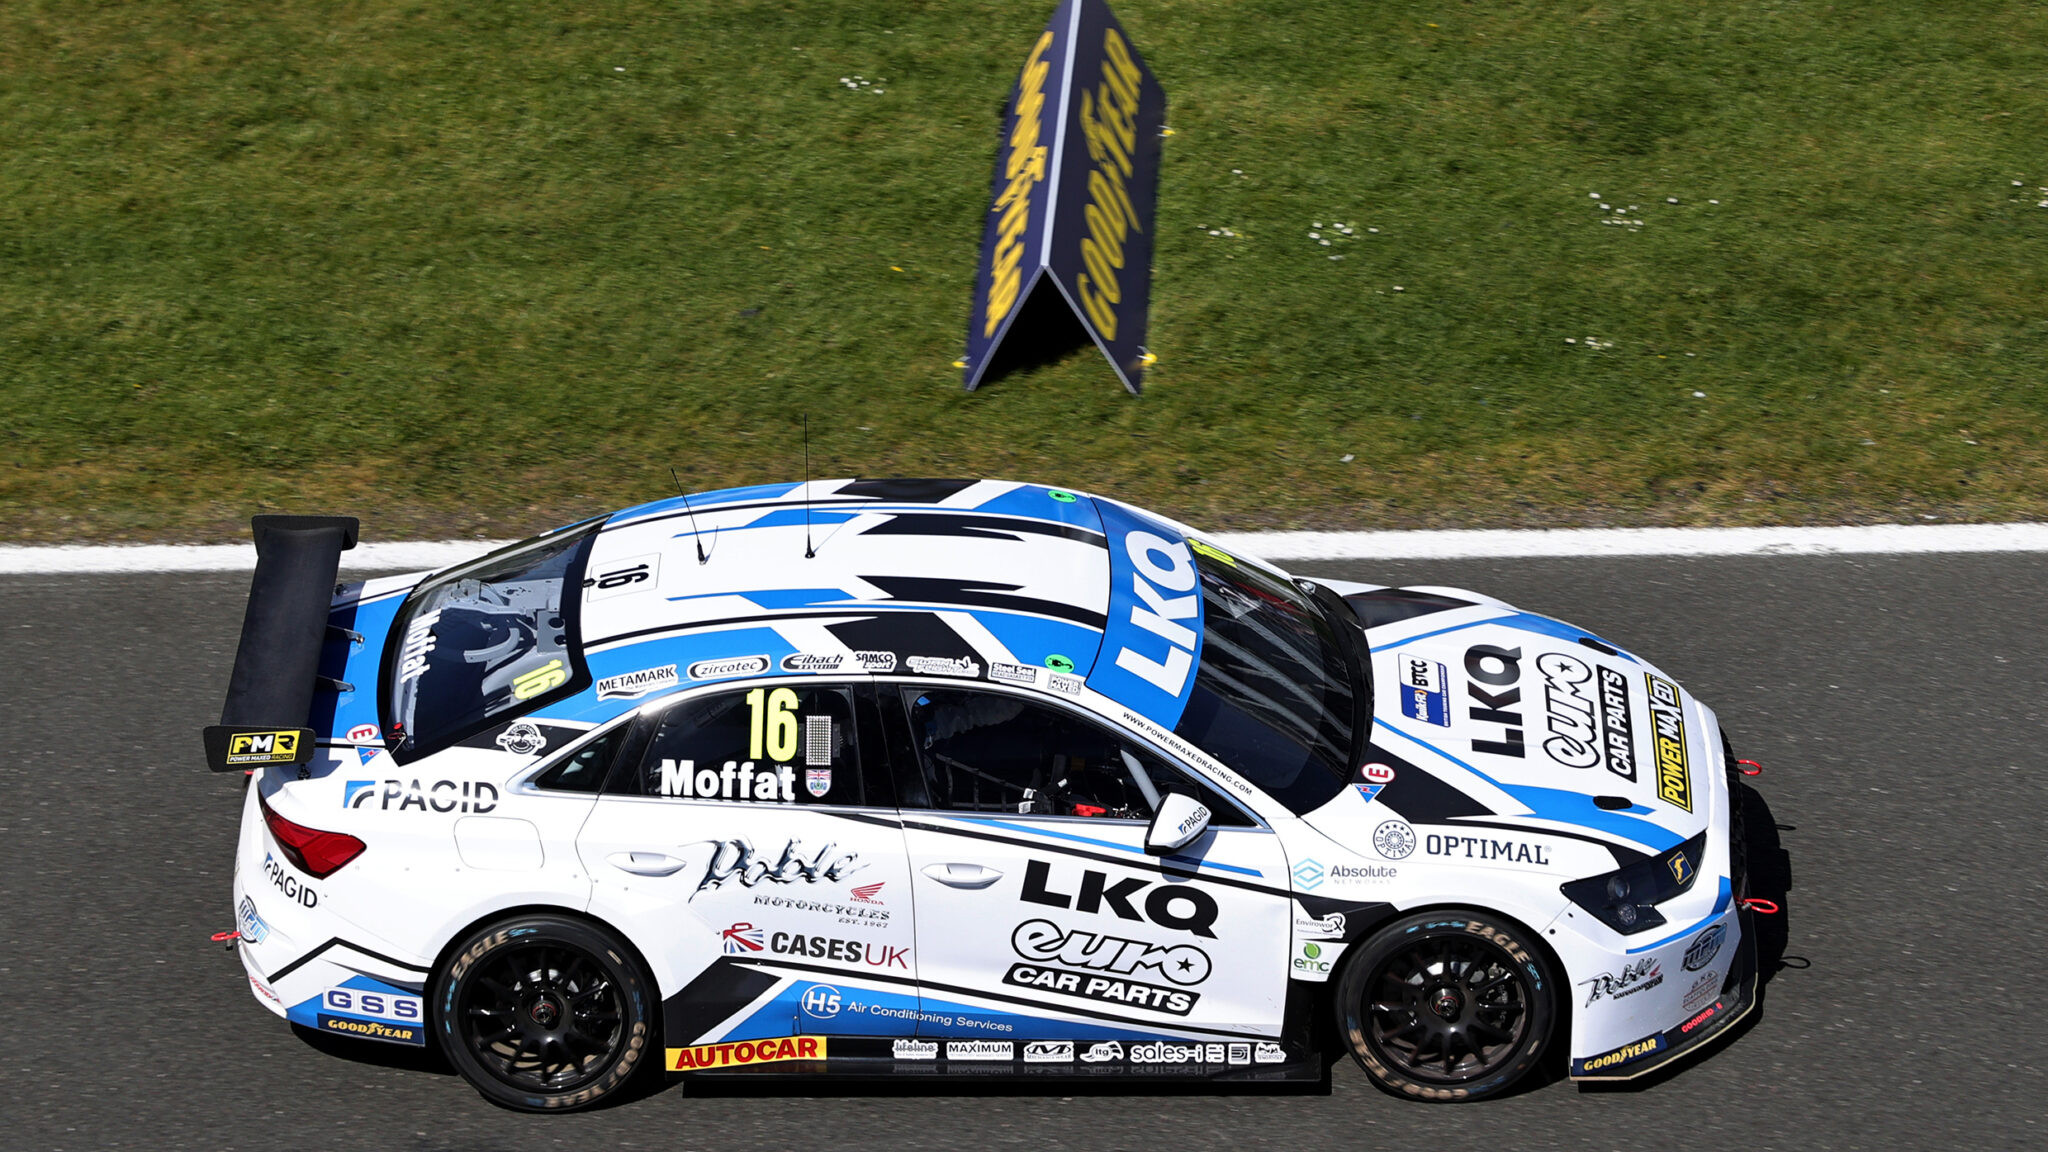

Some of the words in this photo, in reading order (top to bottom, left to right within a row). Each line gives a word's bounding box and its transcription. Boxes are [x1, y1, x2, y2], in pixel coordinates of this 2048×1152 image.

[597, 563, 650, 590] 16
[1115, 530, 1198, 698] LKQ
[700, 659, 758, 675] zircotec
[783, 654, 844, 669] Eibach
[856, 653, 893, 663] SAMCO
[993, 663, 1015, 673] Steel
[1016, 666, 1035, 676] Seal
[1411, 660, 1428, 687] BTCC
[513, 659, 566, 700] 16
[599, 667, 675, 691] METAMARK
[1464, 644, 1525, 759] LKQ
[1536, 652, 1600, 769] euro
[1601, 670, 1628, 733] PARTS
[746, 687, 799, 762] 16
[1123, 712, 1252, 796] WWW.POWERMAXEDRACING.COM
[1608, 732, 1632, 776] CAR
[661, 759, 796, 801] Moffat
[1659, 737, 1687, 805] POWER
[381, 779, 499, 813] PAGID
[1185, 806, 1207, 829] PAGID
[1426, 834, 1549, 865] OPTIMAL
[270, 862, 317, 908] PAGID
[1330, 865, 1397, 878] Absolute
[754, 895, 890, 921] MOTORCYCLES
[850, 897, 885, 905] HONDA
[1020, 859, 1219, 940] LKQ
[452, 929, 509, 982] EAGLE
[1011, 918, 1212, 986] euro
[1464, 920, 1531, 964] EAGLE
[1294, 958, 1330, 972] emc
[328, 990, 418, 1018] GSS
[806, 991, 842, 1013] H5
[1013, 967, 1081, 992] CAR
[1085, 977, 1192, 1011] PARTS
[328, 1019, 413, 1040] GOODYEAR
[847, 1001, 866, 1013] Air
[870, 1004, 951, 1026] Conditioning
[956, 1016, 1013, 1032] Services
[675, 1038, 817, 1070] AUTOCAR
[949, 1043, 1011, 1053] MAXIMUM
[1132, 1044, 1202, 1060] sales-i
[1583, 1038, 1657, 1071] GOODYEAR
